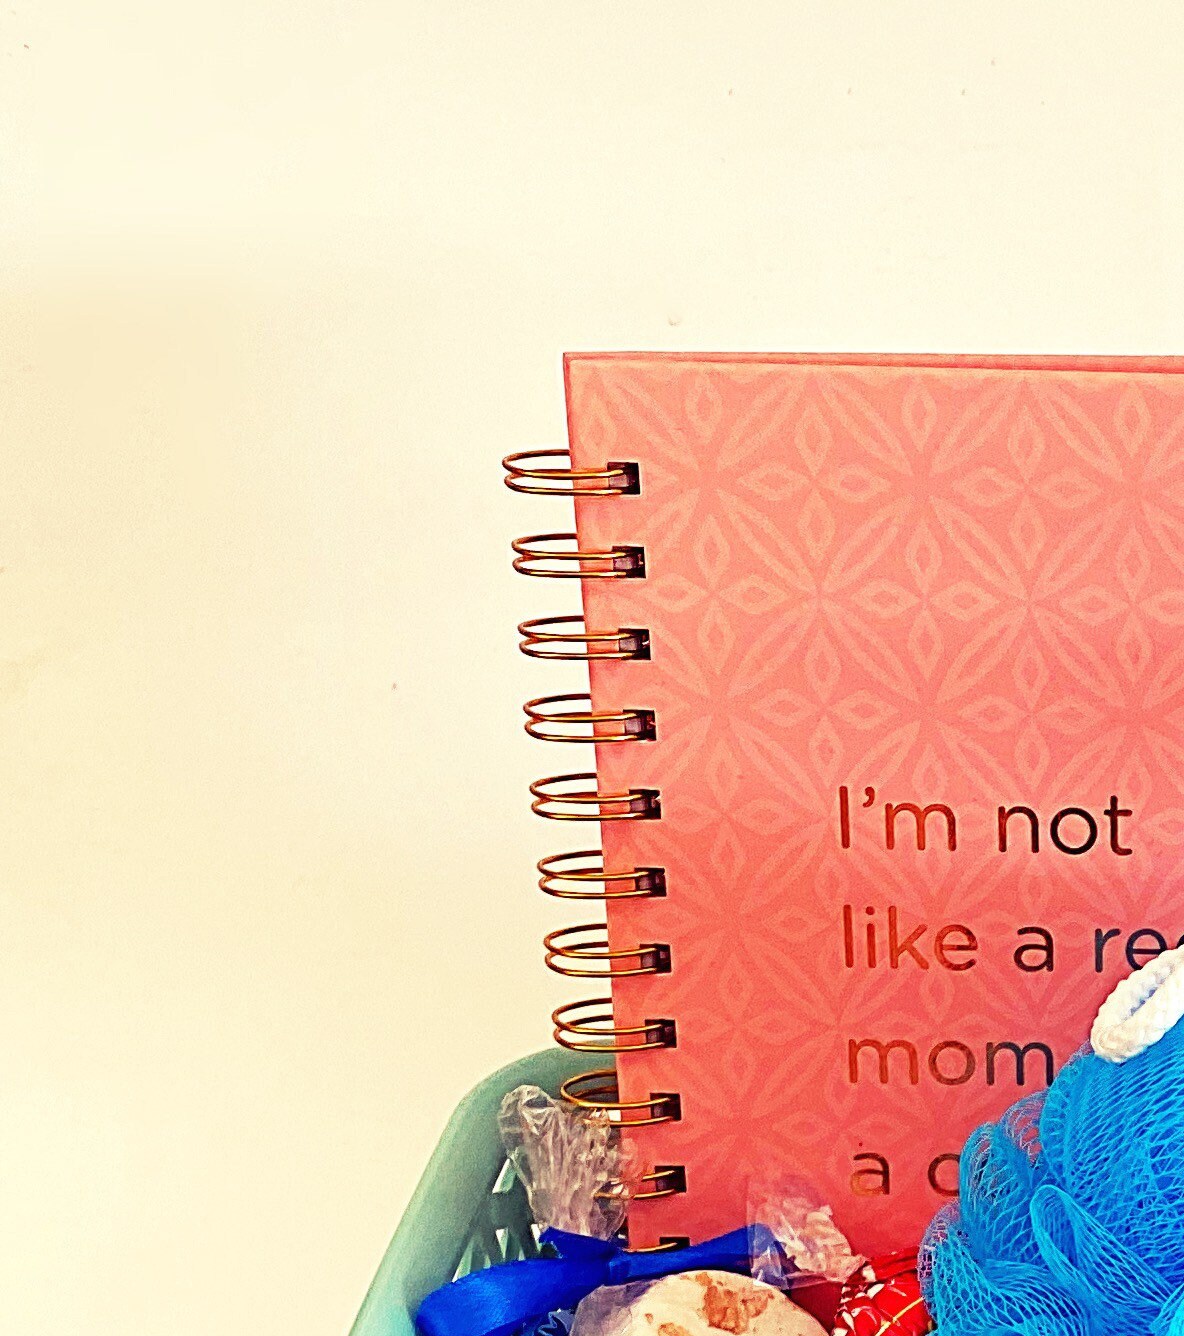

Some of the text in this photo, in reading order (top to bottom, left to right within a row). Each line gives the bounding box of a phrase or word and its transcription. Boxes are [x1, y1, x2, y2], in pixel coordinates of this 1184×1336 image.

[838, 785, 1134, 856] I'm not
[842, 903, 979, 970] like
[1012, 925, 1056, 973] a
[847, 1038, 1055, 1087] mom
[850, 1152, 891, 1197] a
